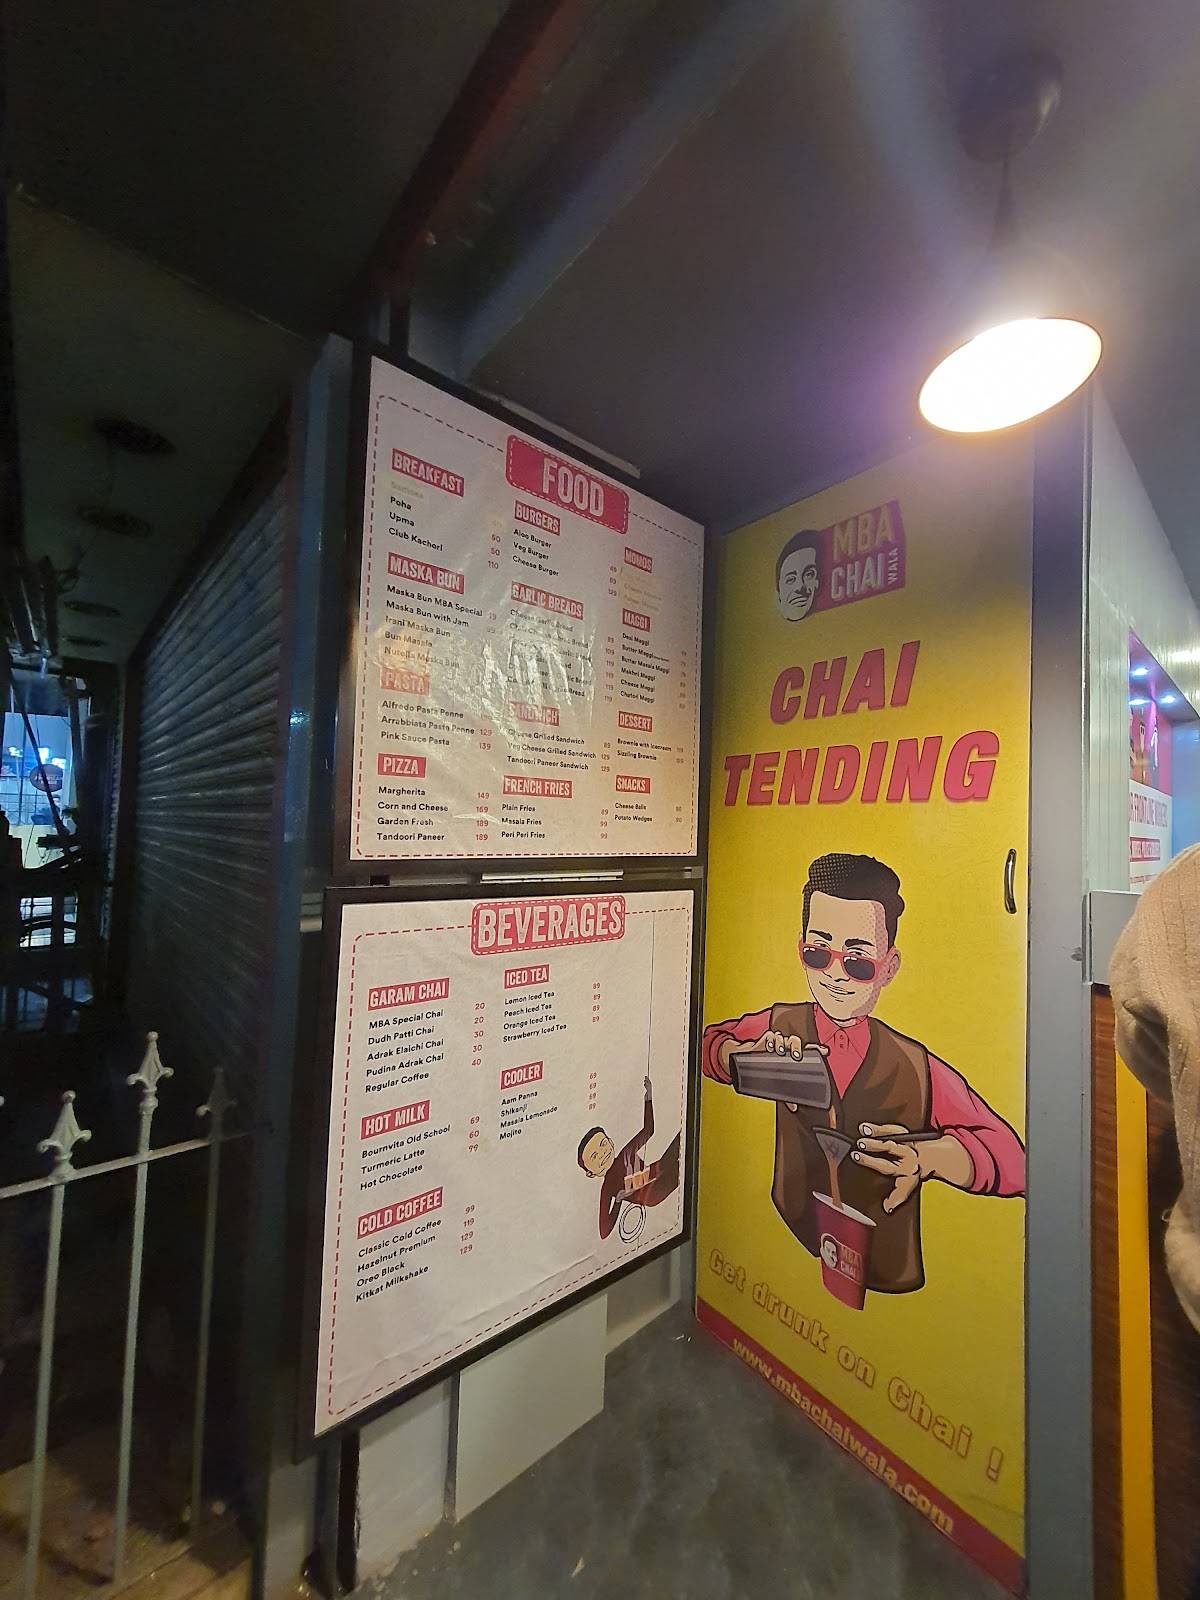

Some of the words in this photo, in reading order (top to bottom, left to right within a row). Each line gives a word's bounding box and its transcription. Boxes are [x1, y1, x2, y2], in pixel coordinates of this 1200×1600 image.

[394, 452, 462, 493] BREAKFAST
[542, 458, 604, 517] FOOD
[390, 496, 412, 510] Poha
[389, 512, 414, 526] Upma
[516, 505, 559, 534] BURGERS
[389, 528, 409, 540] Club
[513, 528, 529, 540] Aloo
[530, 534, 552, 549] Burger
[832, 505, 892, 561] MBA
[513, 541, 526, 554] Veg
[528, 546, 550, 560] Burger
[625, 549, 652, 570] MOMOS
[390, 556, 433, 582] MASKA
[436, 570, 460, 590] BUN
[512, 555, 537, 569] Cheese
[538, 563, 559, 577] Burger
[832, 553, 886, 601] CHAI
[387, 584, 415, 599] Maska
[417, 592, 432, 603] Bun
[434, 598, 453, 609] MBA
[456, 604, 483, 617] Special
[512, 584, 546, 607] GARLIC
[548, 596, 582, 617] BREADS
[386, 600, 414, 614] Maska
[416, 608, 432, 618] Bun
[434, 613, 451, 622] with
[452, 617, 469, 627] Jam
[624, 611, 648, 629] MAGGI
[384, 670, 425, 692] PASTA
[770, 640, 920, 724] CHAI
[381, 716, 426, 729] Arrabbiata
[429, 722, 450, 732] Pasta
[452, 725, 475, 735] Penne
[620, 714, 651, 730] DESSERT
[381, 731, 400, 740] Pink
[401, 734, 426, 743] Sauce
[429, 737, 450, 746] Pasta
[479, 742, 491, 750] 139
[383, 757, 418, 774] PIZZA
[508, 756, 536, 765] Tandoori
[537, 759, 558, 767] Paneer
[560, 761, 589, 771] Sandwich
[724, 730, 1000, 806] TENDING
[378, 786, 426, 796] Margherita
[505, 777, 542, 794] FRENCH
[544, 782, 570, 796] FRIES
[617, 777, 646, 791] SNACKS
[378, 801, 399, 810] Corn
[401, 803, 416, 811] and
[418, 803, 448, 812] Cheese
[377, 817, 409, 826] Garden
[411, 818, 434, 826] Fresh
[377, 833, 416, 841] Tandoori
[417, 833, 445, 841] Paneer
[478, 900, 622, 948] BEVERAGES
[506, 970, 528, 986] ICED
[530, 968, 547, 982] TEA
[370, 986, 415, 1007] GARAM
[419, 981, 446, 1000] CHAI
[505, 996, 527, 1005] Lemon
[369, 1019, 390, 1030] MBA
[392, 1012, 423, 1026] Special
[426, 1009, 443, 1019] Chai
[504, 1009, 524, 1017] Peach
[525, 1005, 540, 1013] Iced
[504, 1021, 528, 1030] Orange
[529, 1016, 543, 1024] Iced
[368, 1034, 392, 1045] Dudh
[394, 1029, 414, 1040] Patti
[415, 1026, 434, 1036] Chai
[473, 1030, 484, 1038] 30
[503, 1029, 540, 1042] Strawberry
[541, 1026, 555, 1034] Iced
[366, 1049, 393, 1061] Adrak
[396, 1042, 423, 1054] Elaichi
[426, 1038, 444, 1048] Chai
[366, 1065, 396, 1077] Pudina
[398, 1058, 423, 1070] Adrak
[426, 1053, 444, 1063] Chai
[472, 1058, 481, 1066] 40
[365, 1079, 399, 1093] Regular
[401, 1072, 429, 1084] Coffee
[504, 1065, 540, 1086] COOLER
[518, 1091, 538, 1101] Panna
[365, 1114, 391, 1135] HOT
[395, 1104, 426, 1126] MILK
[470, 1116, 480, 1124] 69
[500, 1117, 524, 1128] Masala
[525, 1106, 558, 1120] Lemonade
[362, 1141, 405, 1158] Bournvita
[406, 1134, 422, 1144] Old
[423, 1124, 451, 1139] School
[469, 1130, 479, 1138] 60
[500, 1129, 522, 1140] Mojito
[361, 1156, 402, 1174] Turmeric
[403, 1149, 425, 1160] Latte
[360, 1179, 377, 1191] Hot
[378, 1164, 423, 1183] Chocolate
[360, 1210, 392, 1235] COLD
[396, 1190, 441, 1220] COFFEE
[465, 1205, 475, 1214] 99
[463, 1218, 474, 1227] 119
[358, 1240, 390, 1258] Classic
[392, 1230, 413, 1244] Cold
[414, 1219, 442, 1234] Coffee
[461, 1231, 474, 1242] 129
[358, 1252, 397, 1273] Hazelnut
[399, 1235, 436, 1256] Premium
[460, 1244, 473, 1255] 129
[356, 1285, 384, 1302] Kitkat
[385, 1266, 429, 1289] Milkshake
[357, 1274, 379, 1287] Oreo
[381, 1261, 405, 1277] Black
[710, 1249, 747, 1293] Get
[752, 1283, 830, 1353] drunk
[838, 1346, 876, 1388] on
[888, 1377, 972, 1458] Chai
[986, 1447, 1004, 1482] !
